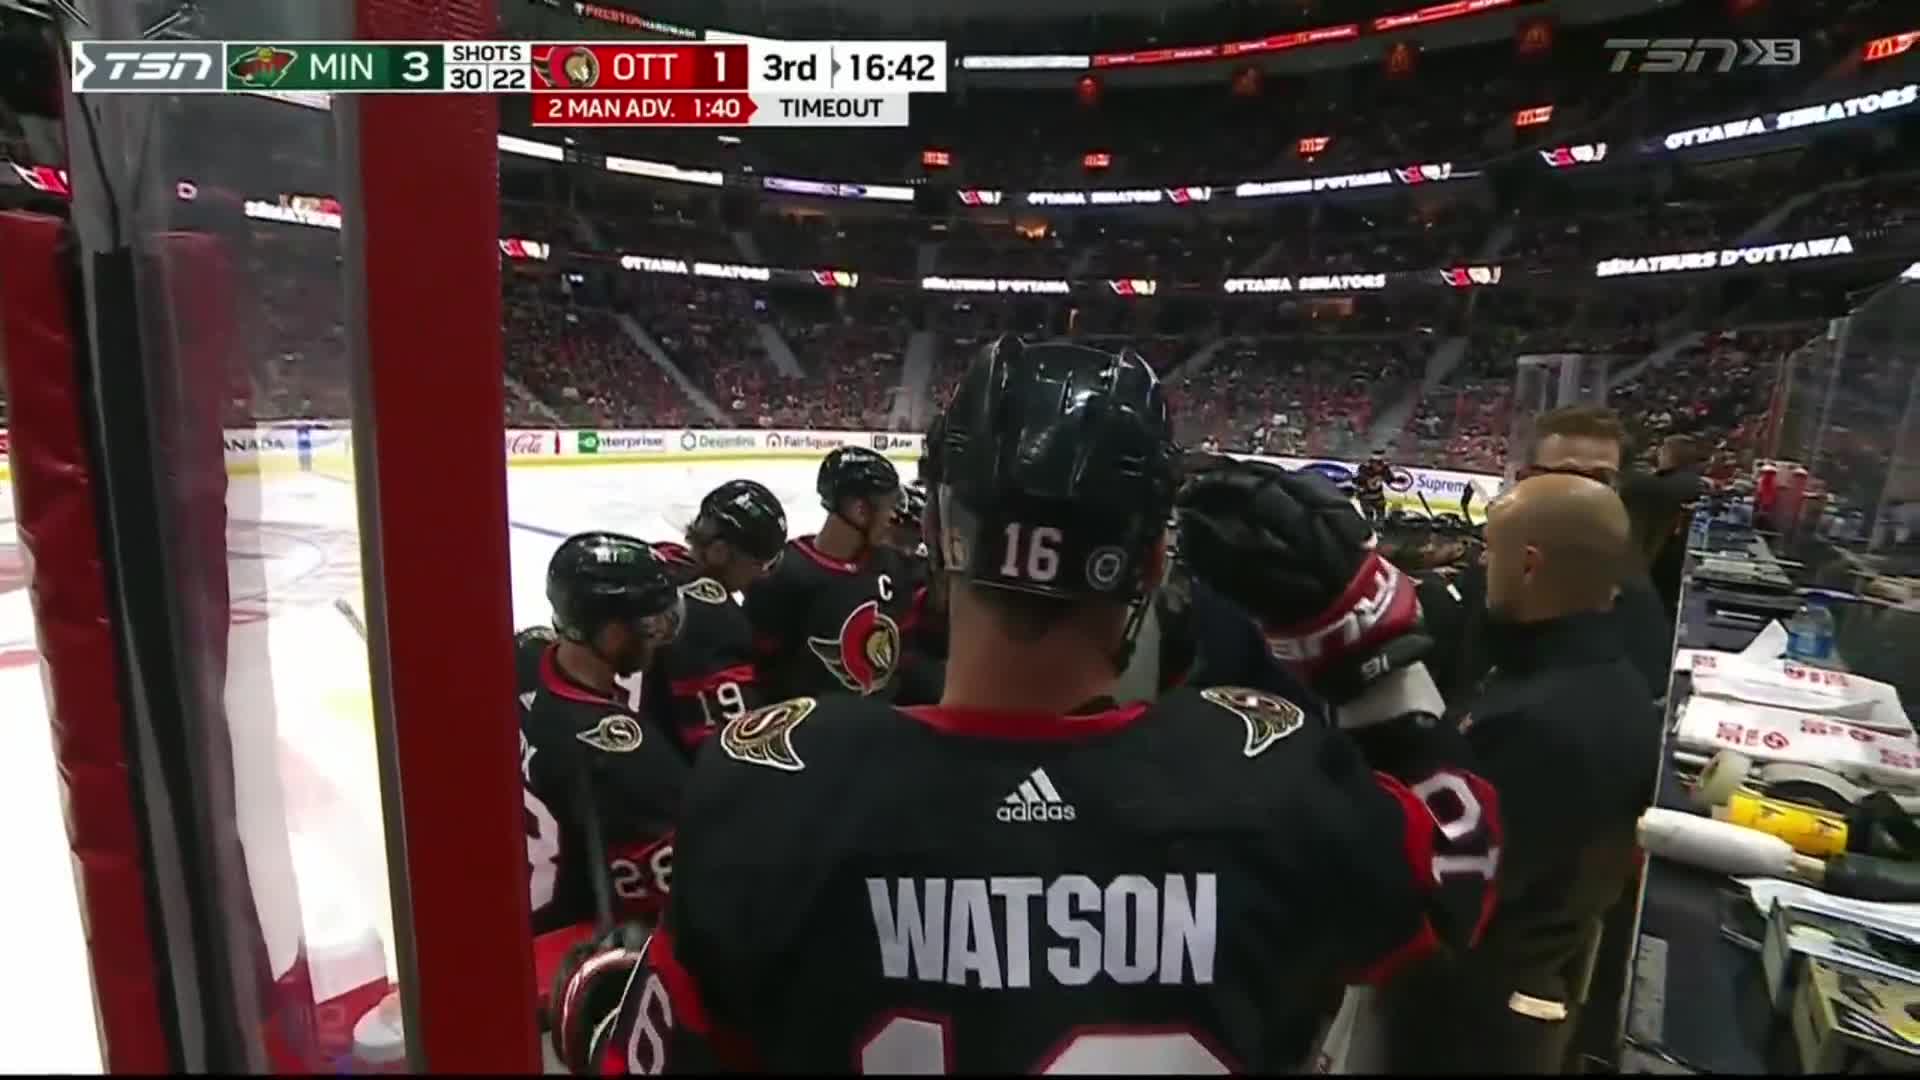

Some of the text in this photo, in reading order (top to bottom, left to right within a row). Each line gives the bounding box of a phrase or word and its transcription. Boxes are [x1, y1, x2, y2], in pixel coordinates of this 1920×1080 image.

[1665, 85, 1918, 149] OTTAWA SENATORS
[1721, 235, 1853, 266] D'OTTAWA
[223, 438, 286, 451] ANADA
[1416, 472, 1467, 493] Suprem
[1001, 526, 1063, 581] 16
[877, 573, 894, 600] C
[696, 682, 746, 726] 19
[996, 799, 1077, 822] adidas
[865, 872, 1218, 989] WATSON
